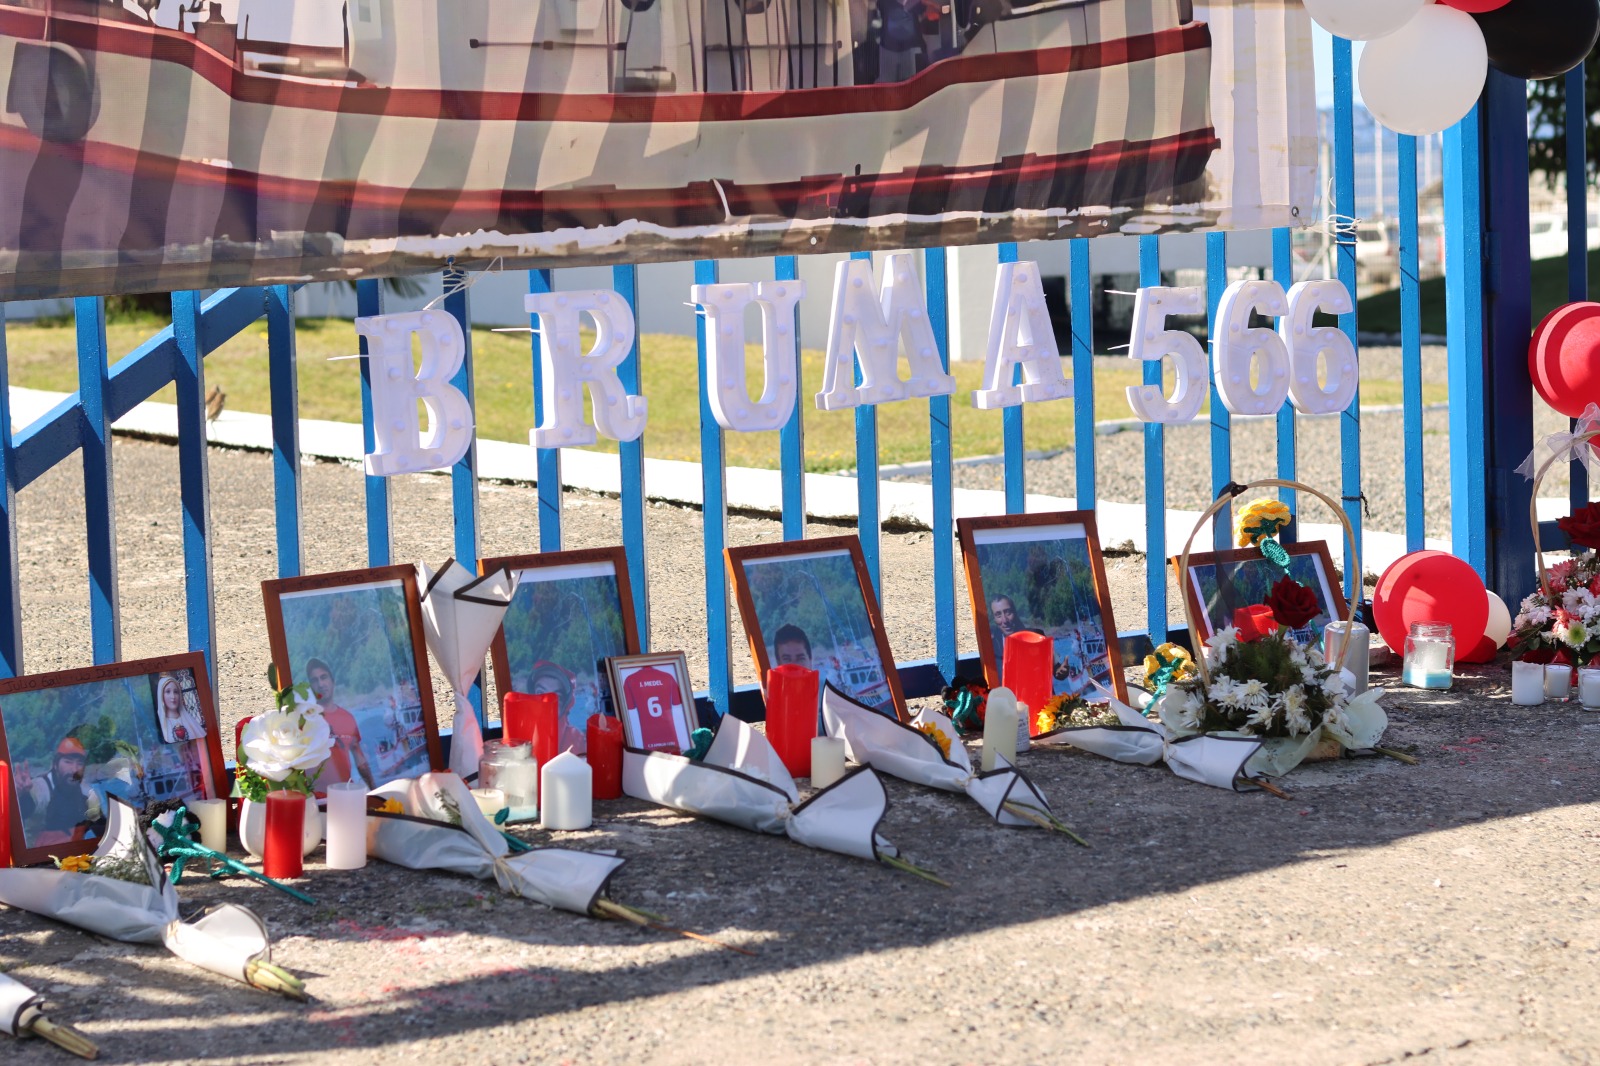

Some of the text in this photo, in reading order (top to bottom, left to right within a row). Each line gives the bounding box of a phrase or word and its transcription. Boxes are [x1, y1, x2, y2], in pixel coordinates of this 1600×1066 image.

[355, 253, 1358, 477] BRUMA 566
[644, 679, 664, 687] MEDEL
[647, 696, 663, 718] 6
